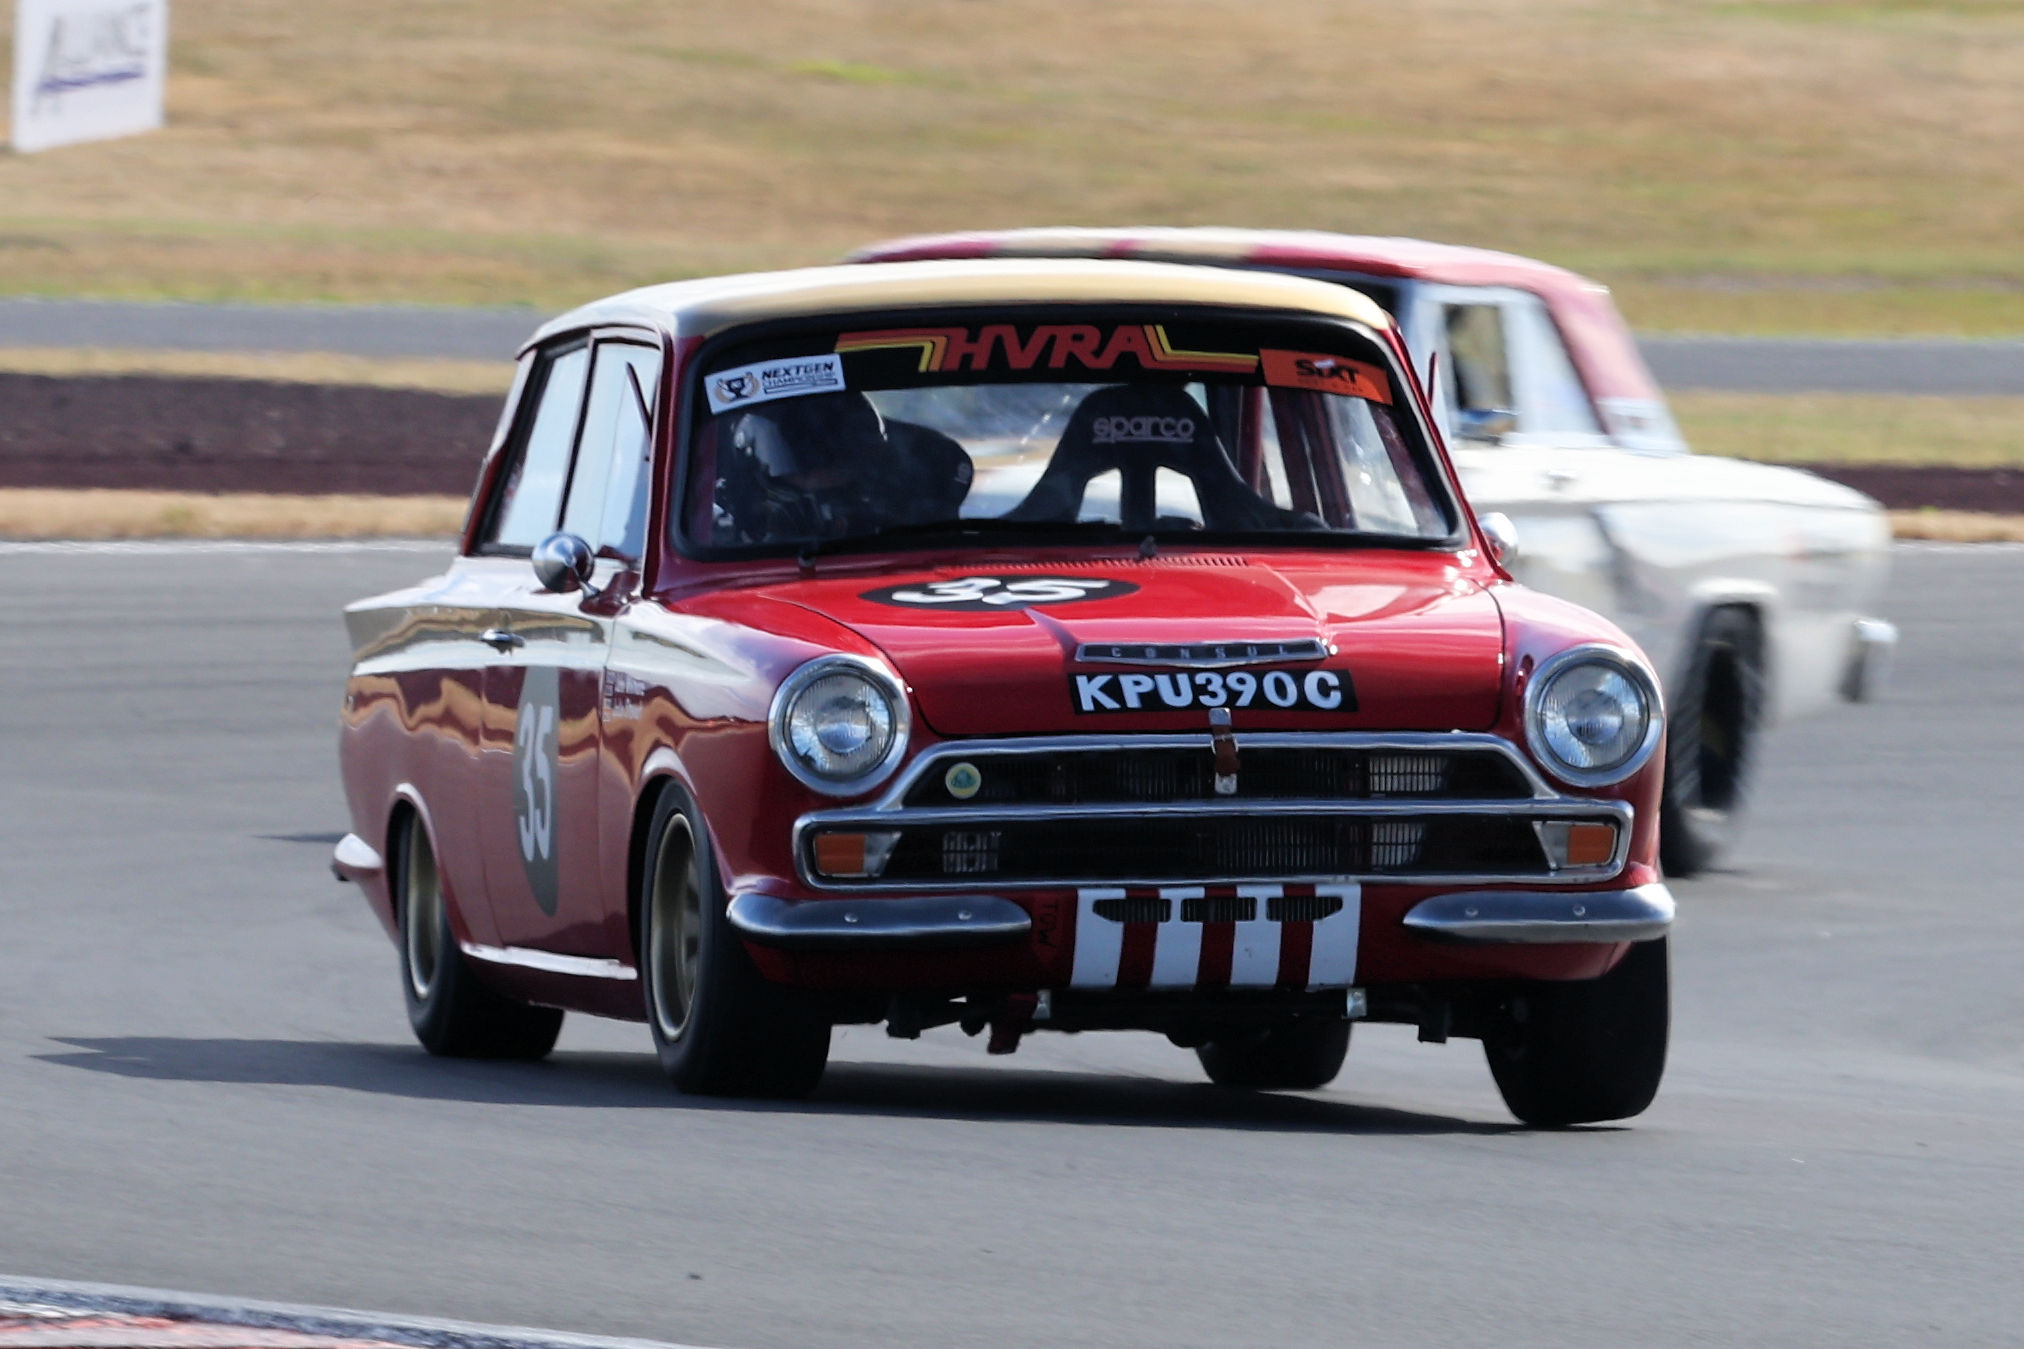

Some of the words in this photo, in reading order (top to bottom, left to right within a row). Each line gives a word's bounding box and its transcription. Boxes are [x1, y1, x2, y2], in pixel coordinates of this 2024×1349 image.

[942, 324, 1151, 370] HVRA
[762, 361, 834, 379] NEXTGEN
[1092, 415, 1195, 443] sparco
[892, 577, 1110, 605] 35
[1111, 643, 1288, 658] CONSUL
[1075, 670, 1342, 711] KPU390C
[519, 702, 553, 861] 35
